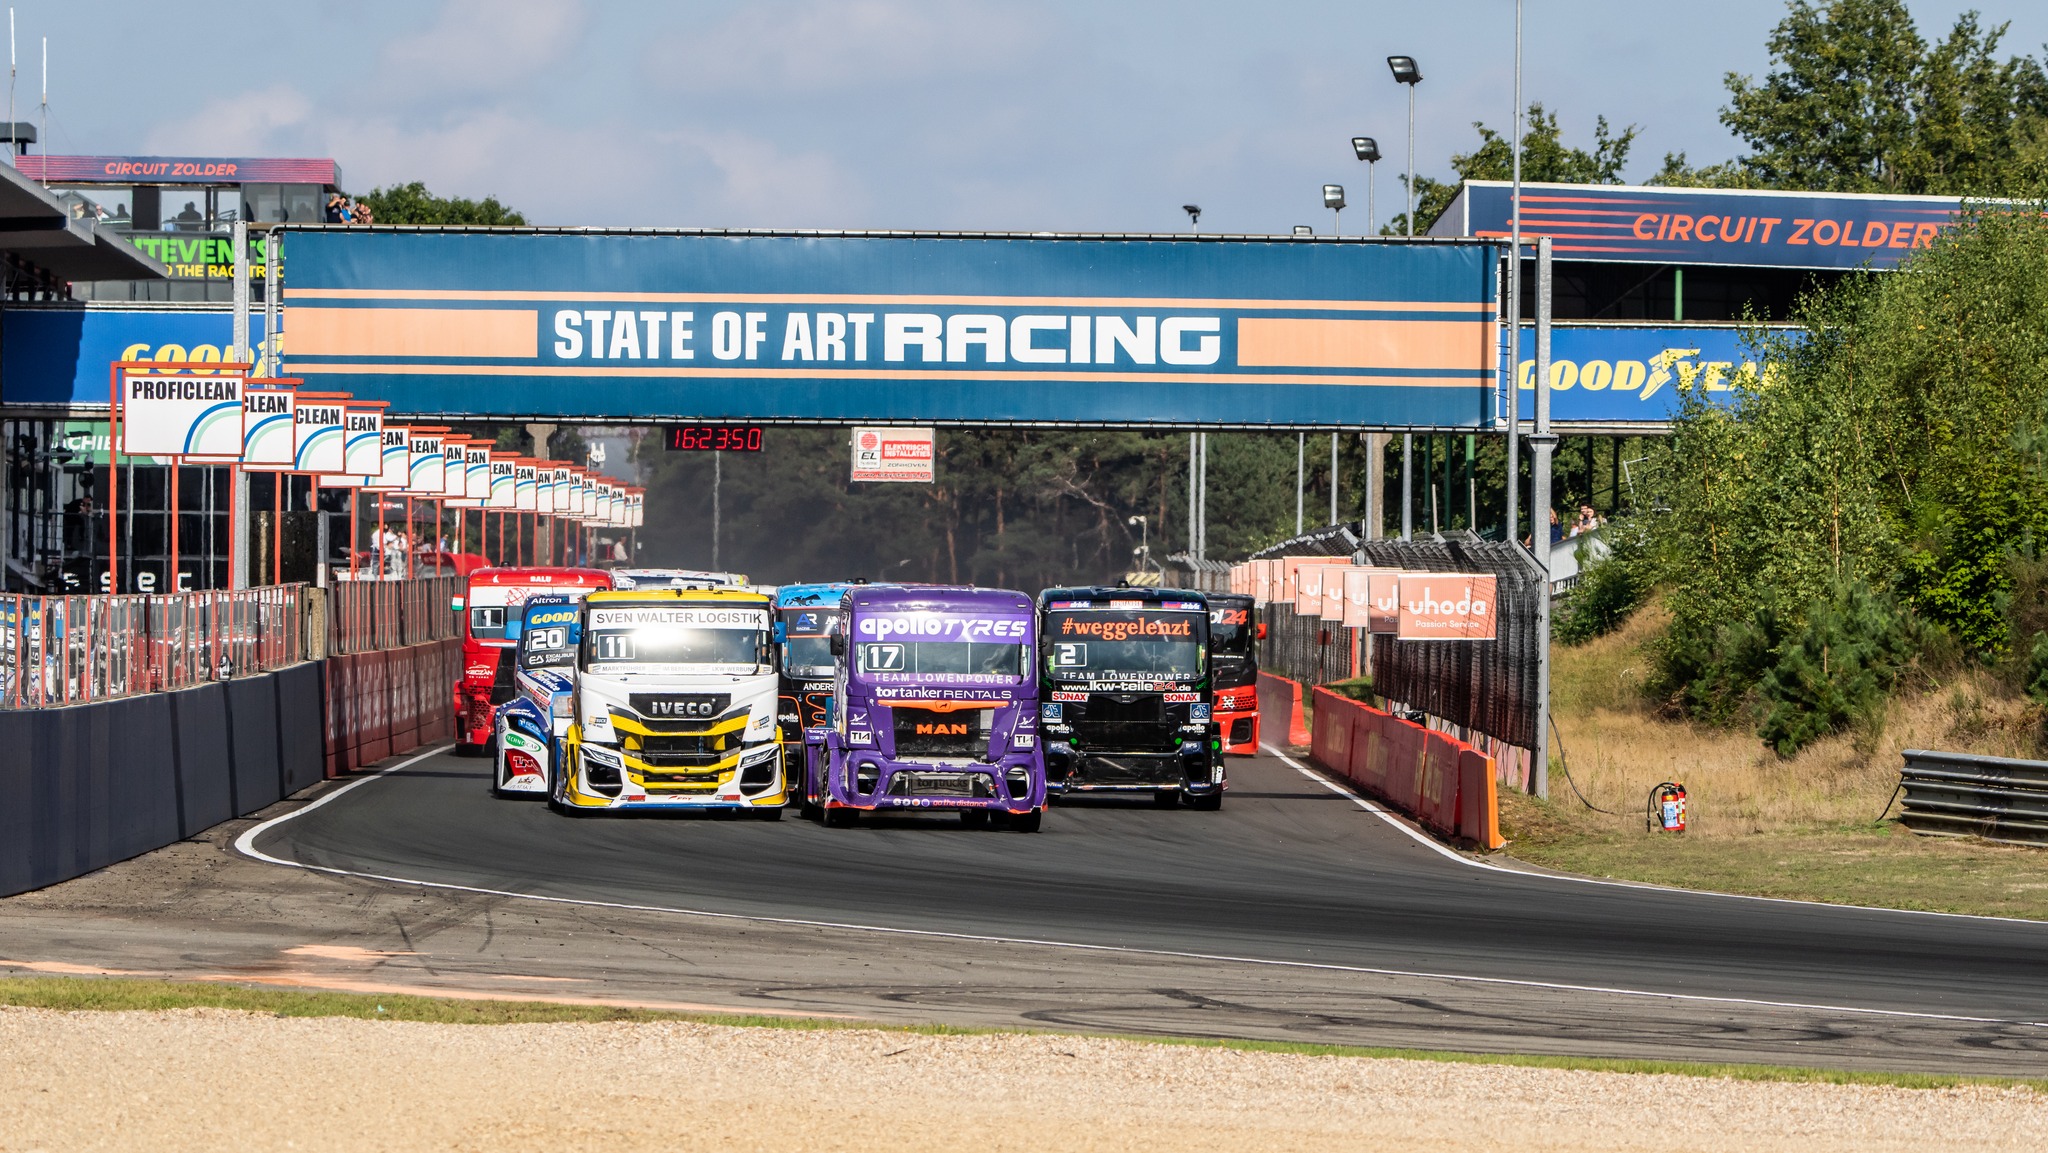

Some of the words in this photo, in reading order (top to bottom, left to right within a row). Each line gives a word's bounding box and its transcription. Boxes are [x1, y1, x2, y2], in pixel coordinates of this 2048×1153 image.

[105, 162, 170, 176] CIRCUIT
[170, 163, 238, 176] ZOLDER
[1633, 213, 1781, 244] CIRCUIT
[1787, 218, 1939, 250] ZOLDER
[176, 264, 204, 278] THE
[554, 309, 695, 360] STATE
[712, 311, 767, 361] OF
[781, 312, 875, 361] ART
[884, 313, 1221, 365] RACING
[132, 380, 236, 400] PROFICLEAN
[675, 428, 761, 450] 16:23:50
[861, 451, 877, 460] EL
[531, 597, 562, 605] Altron
[1408, 587, 1486, 615] uhoda
[484, 609, 491, 627] 1
[596, 613, 633, 624] SVEN
[637, 612, 694, 623] WALTER
[699, 612, 762, 624] LOGISTIK
[1415, 619, 1447, 628] Passion
[1449, 620, 1479, 628] Service
[1062, 617, 1191, 641] #weggelenzt
[532, 629, 563, 650] 20
[606, 636, 627, 658] 11
[870, 646, 899, 668] 17
[1060, 645, 1076, 665] 2
[874, 673, 910, 682] TEAM
[1062, 672, 1095, 680] TEAM
[1061, 681, 1192, 692] www.lkw-teile24.de
[944, 690, 1012, 699] RENTALS
[1052, 692, 1086, 701] SONAX
[1164, 694, 1198, 702] SONAX
[652, 701, 713, 715] IVECO
[916, 724, 967, 734] MAN
